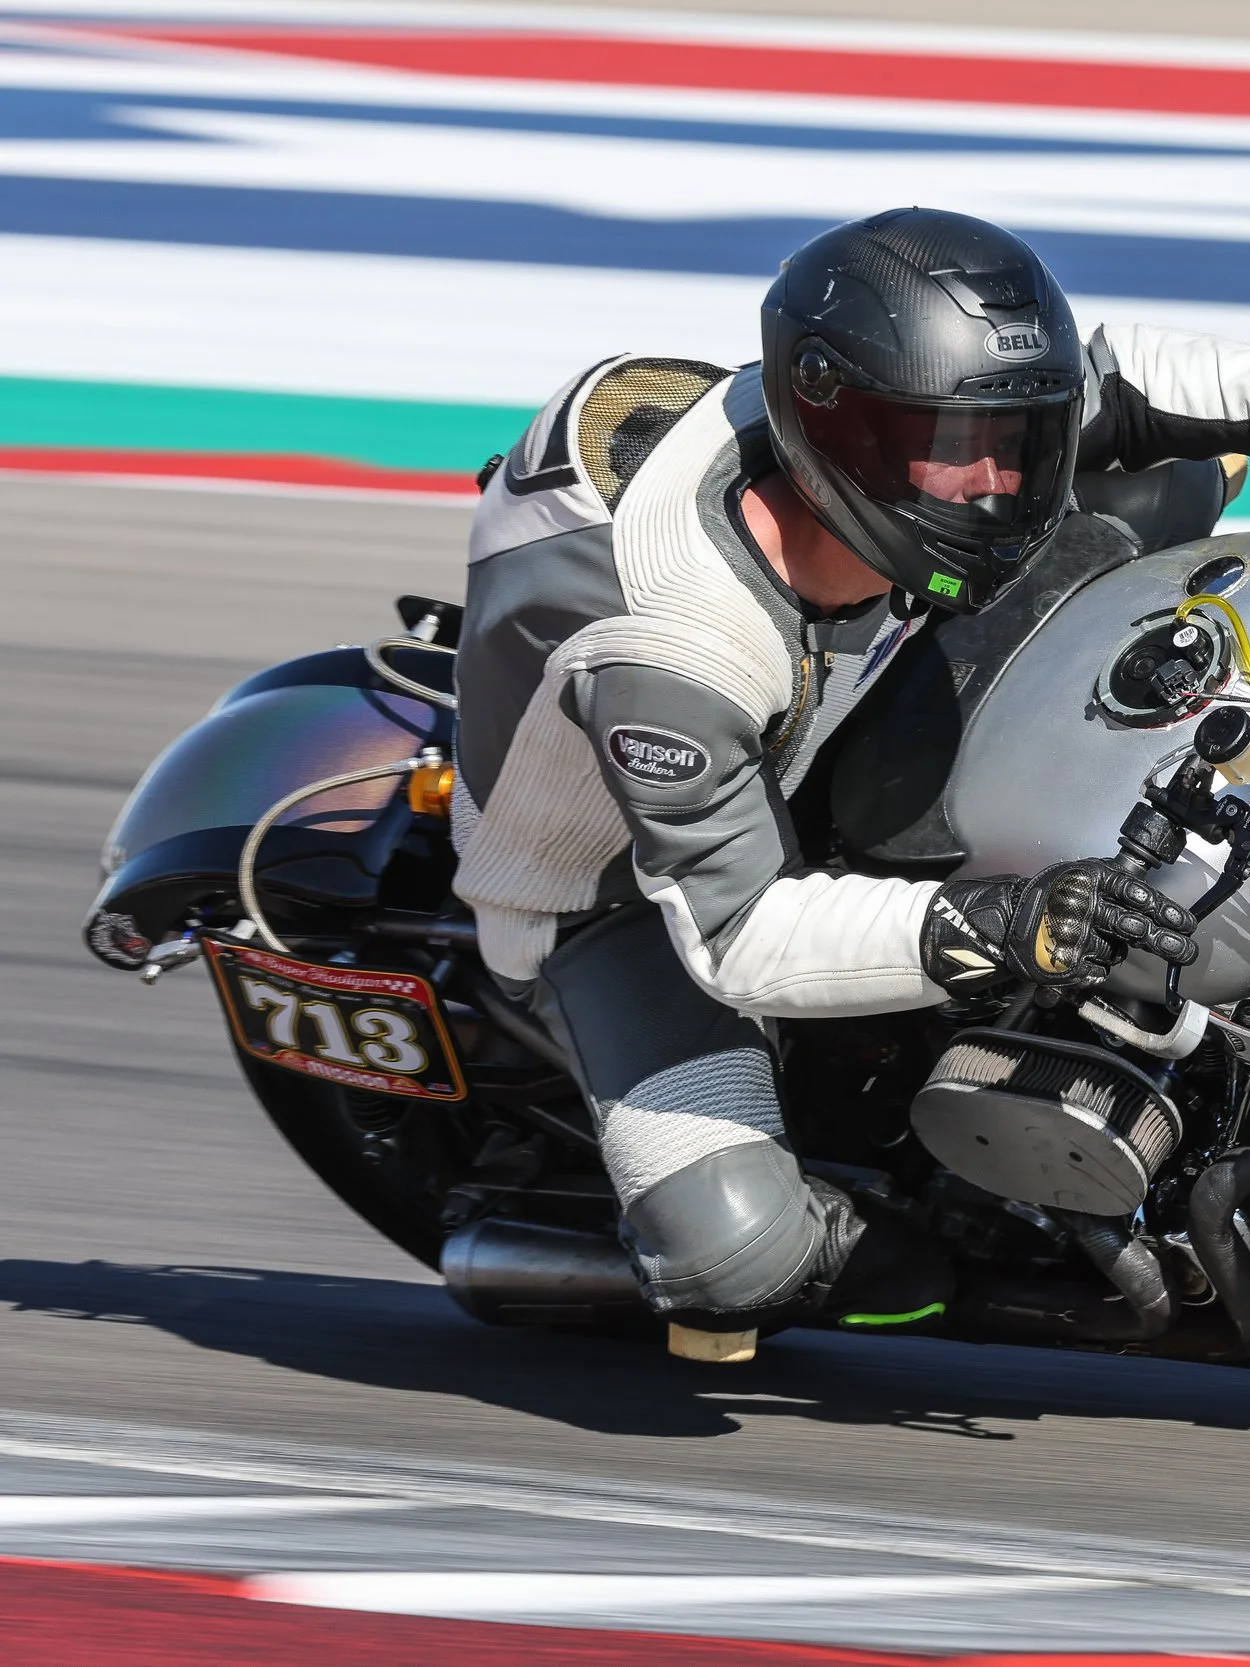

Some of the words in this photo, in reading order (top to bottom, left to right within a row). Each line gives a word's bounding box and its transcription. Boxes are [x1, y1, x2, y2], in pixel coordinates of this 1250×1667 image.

[996, 333, 1043, 352] BELL
[789, 449, 823, 500] BELL
[239, 976, 429, 1074] 713
